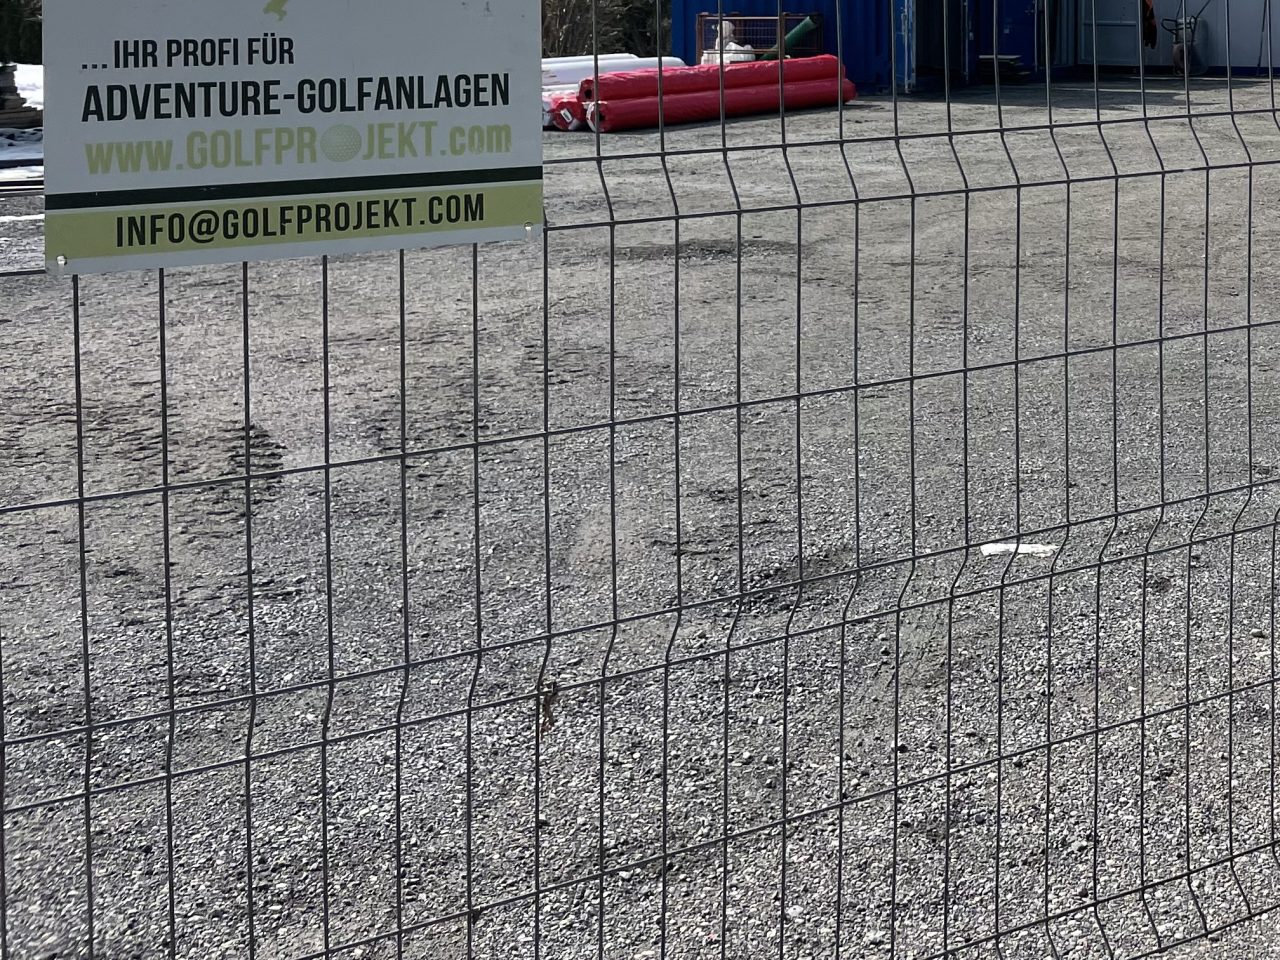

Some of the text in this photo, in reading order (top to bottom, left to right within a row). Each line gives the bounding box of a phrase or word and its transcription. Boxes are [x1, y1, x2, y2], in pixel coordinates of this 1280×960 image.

[166, 38, 239, 67] PROFI
[247, 32, 294, 65] FÜR
[81, 73, 510, 123] ADVENTURE-GOLFANLAGEN
[116, 193, 485, 248] INFO@GOLFPROJEKT.COM
